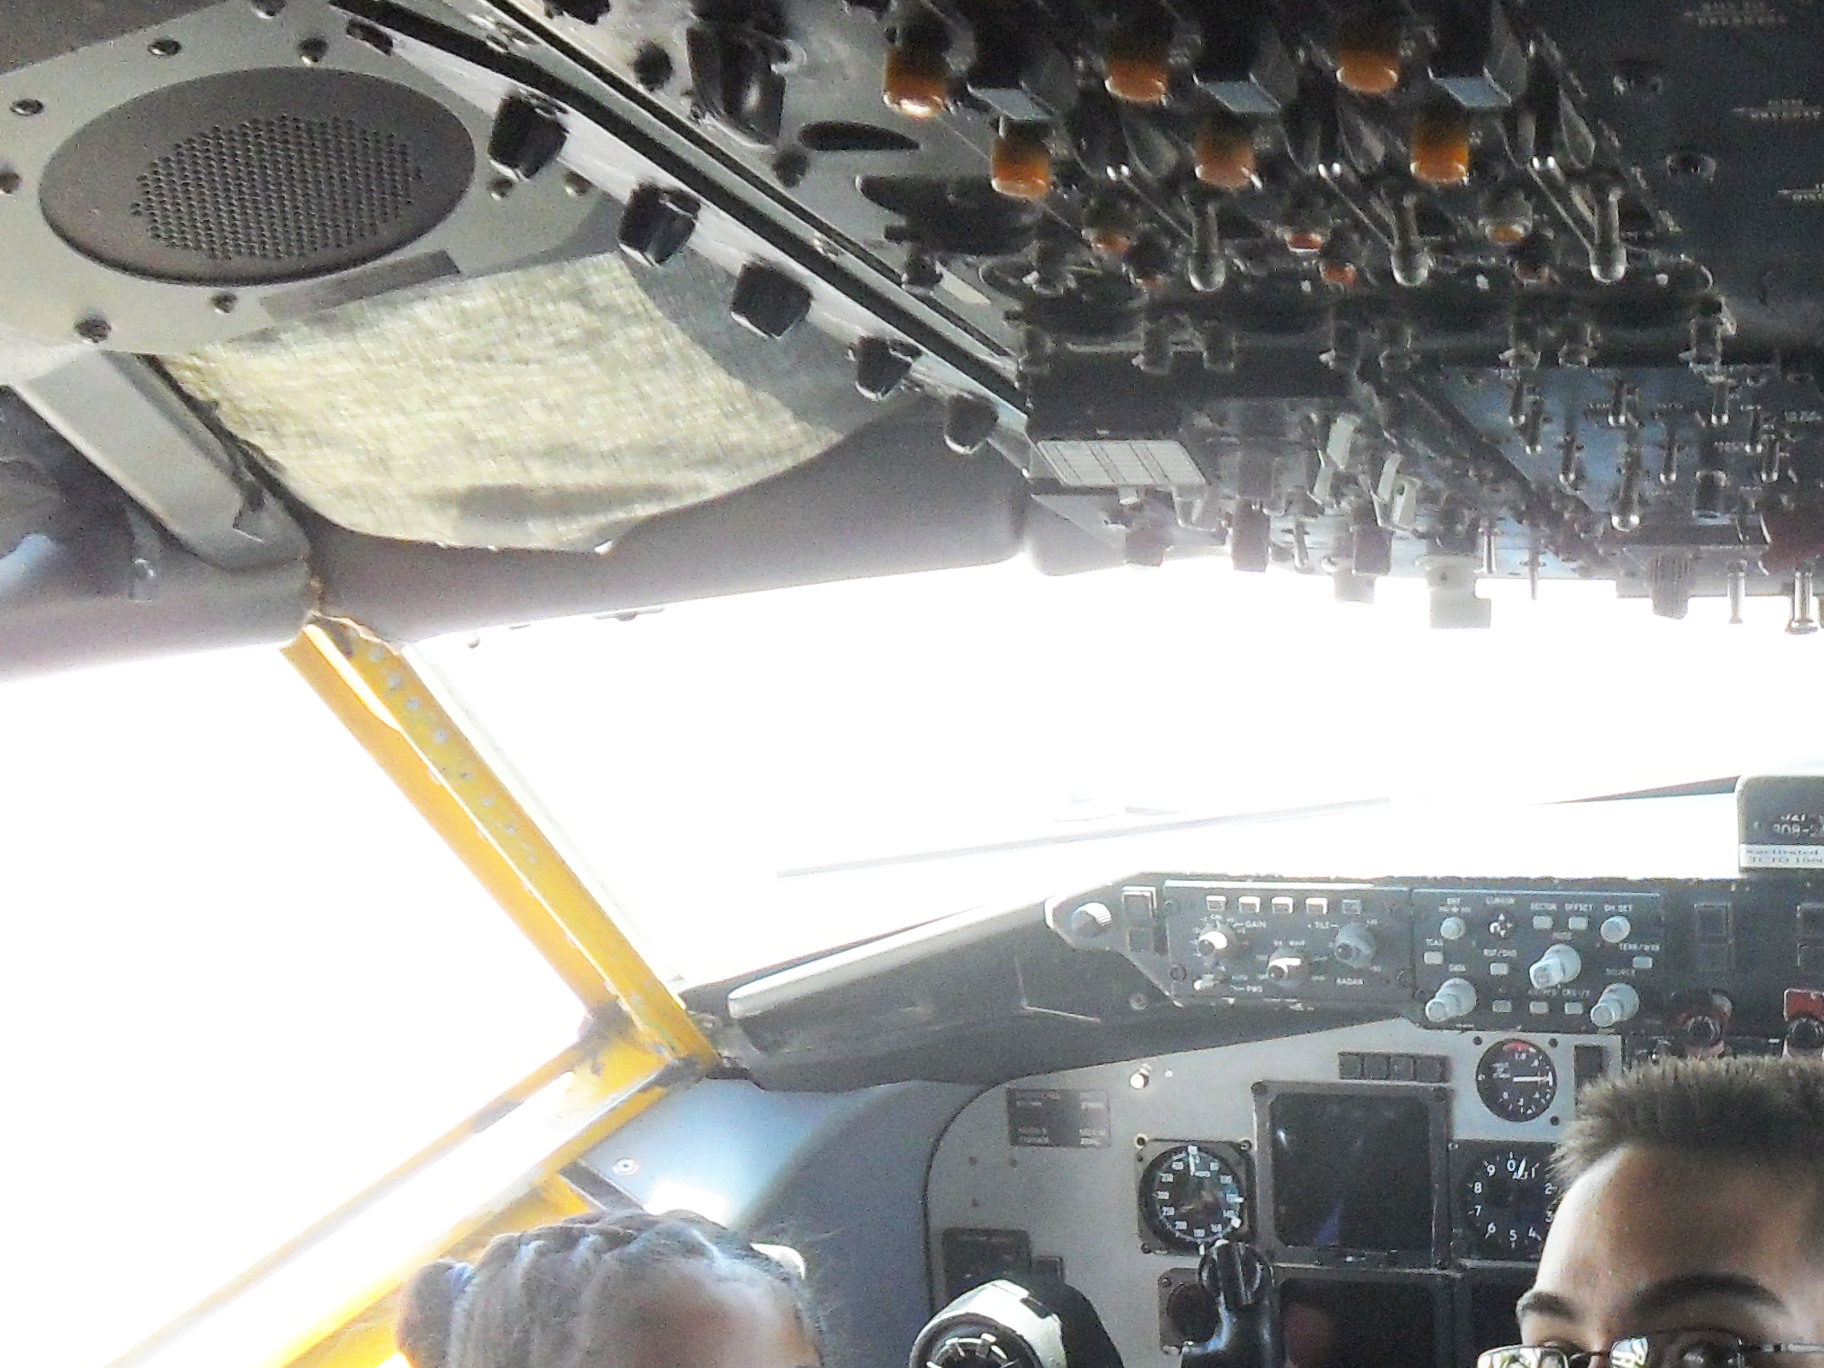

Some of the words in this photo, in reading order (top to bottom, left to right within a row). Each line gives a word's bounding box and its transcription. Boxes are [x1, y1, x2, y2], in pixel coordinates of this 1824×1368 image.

[1564, 903, 1593, 911] OFFSET
[1245, 920, 1268, 929] GAIN
[1486, 1164, 1496, 1177] 9
[1506, 1159, 1516, 1172] 0
[1473, 1181, 1483, 1194] 8
[1544, 1182, 1554, 1195] 2
[1474, 1204, 1482, 1217] 7
[1545, 1210, 1554, 1223] 3
[1487, 1221, 1497, 1234] 6
[1527, 1226, 1537, 1238] 4
[1509, 1229, 1518, 1241] 5
